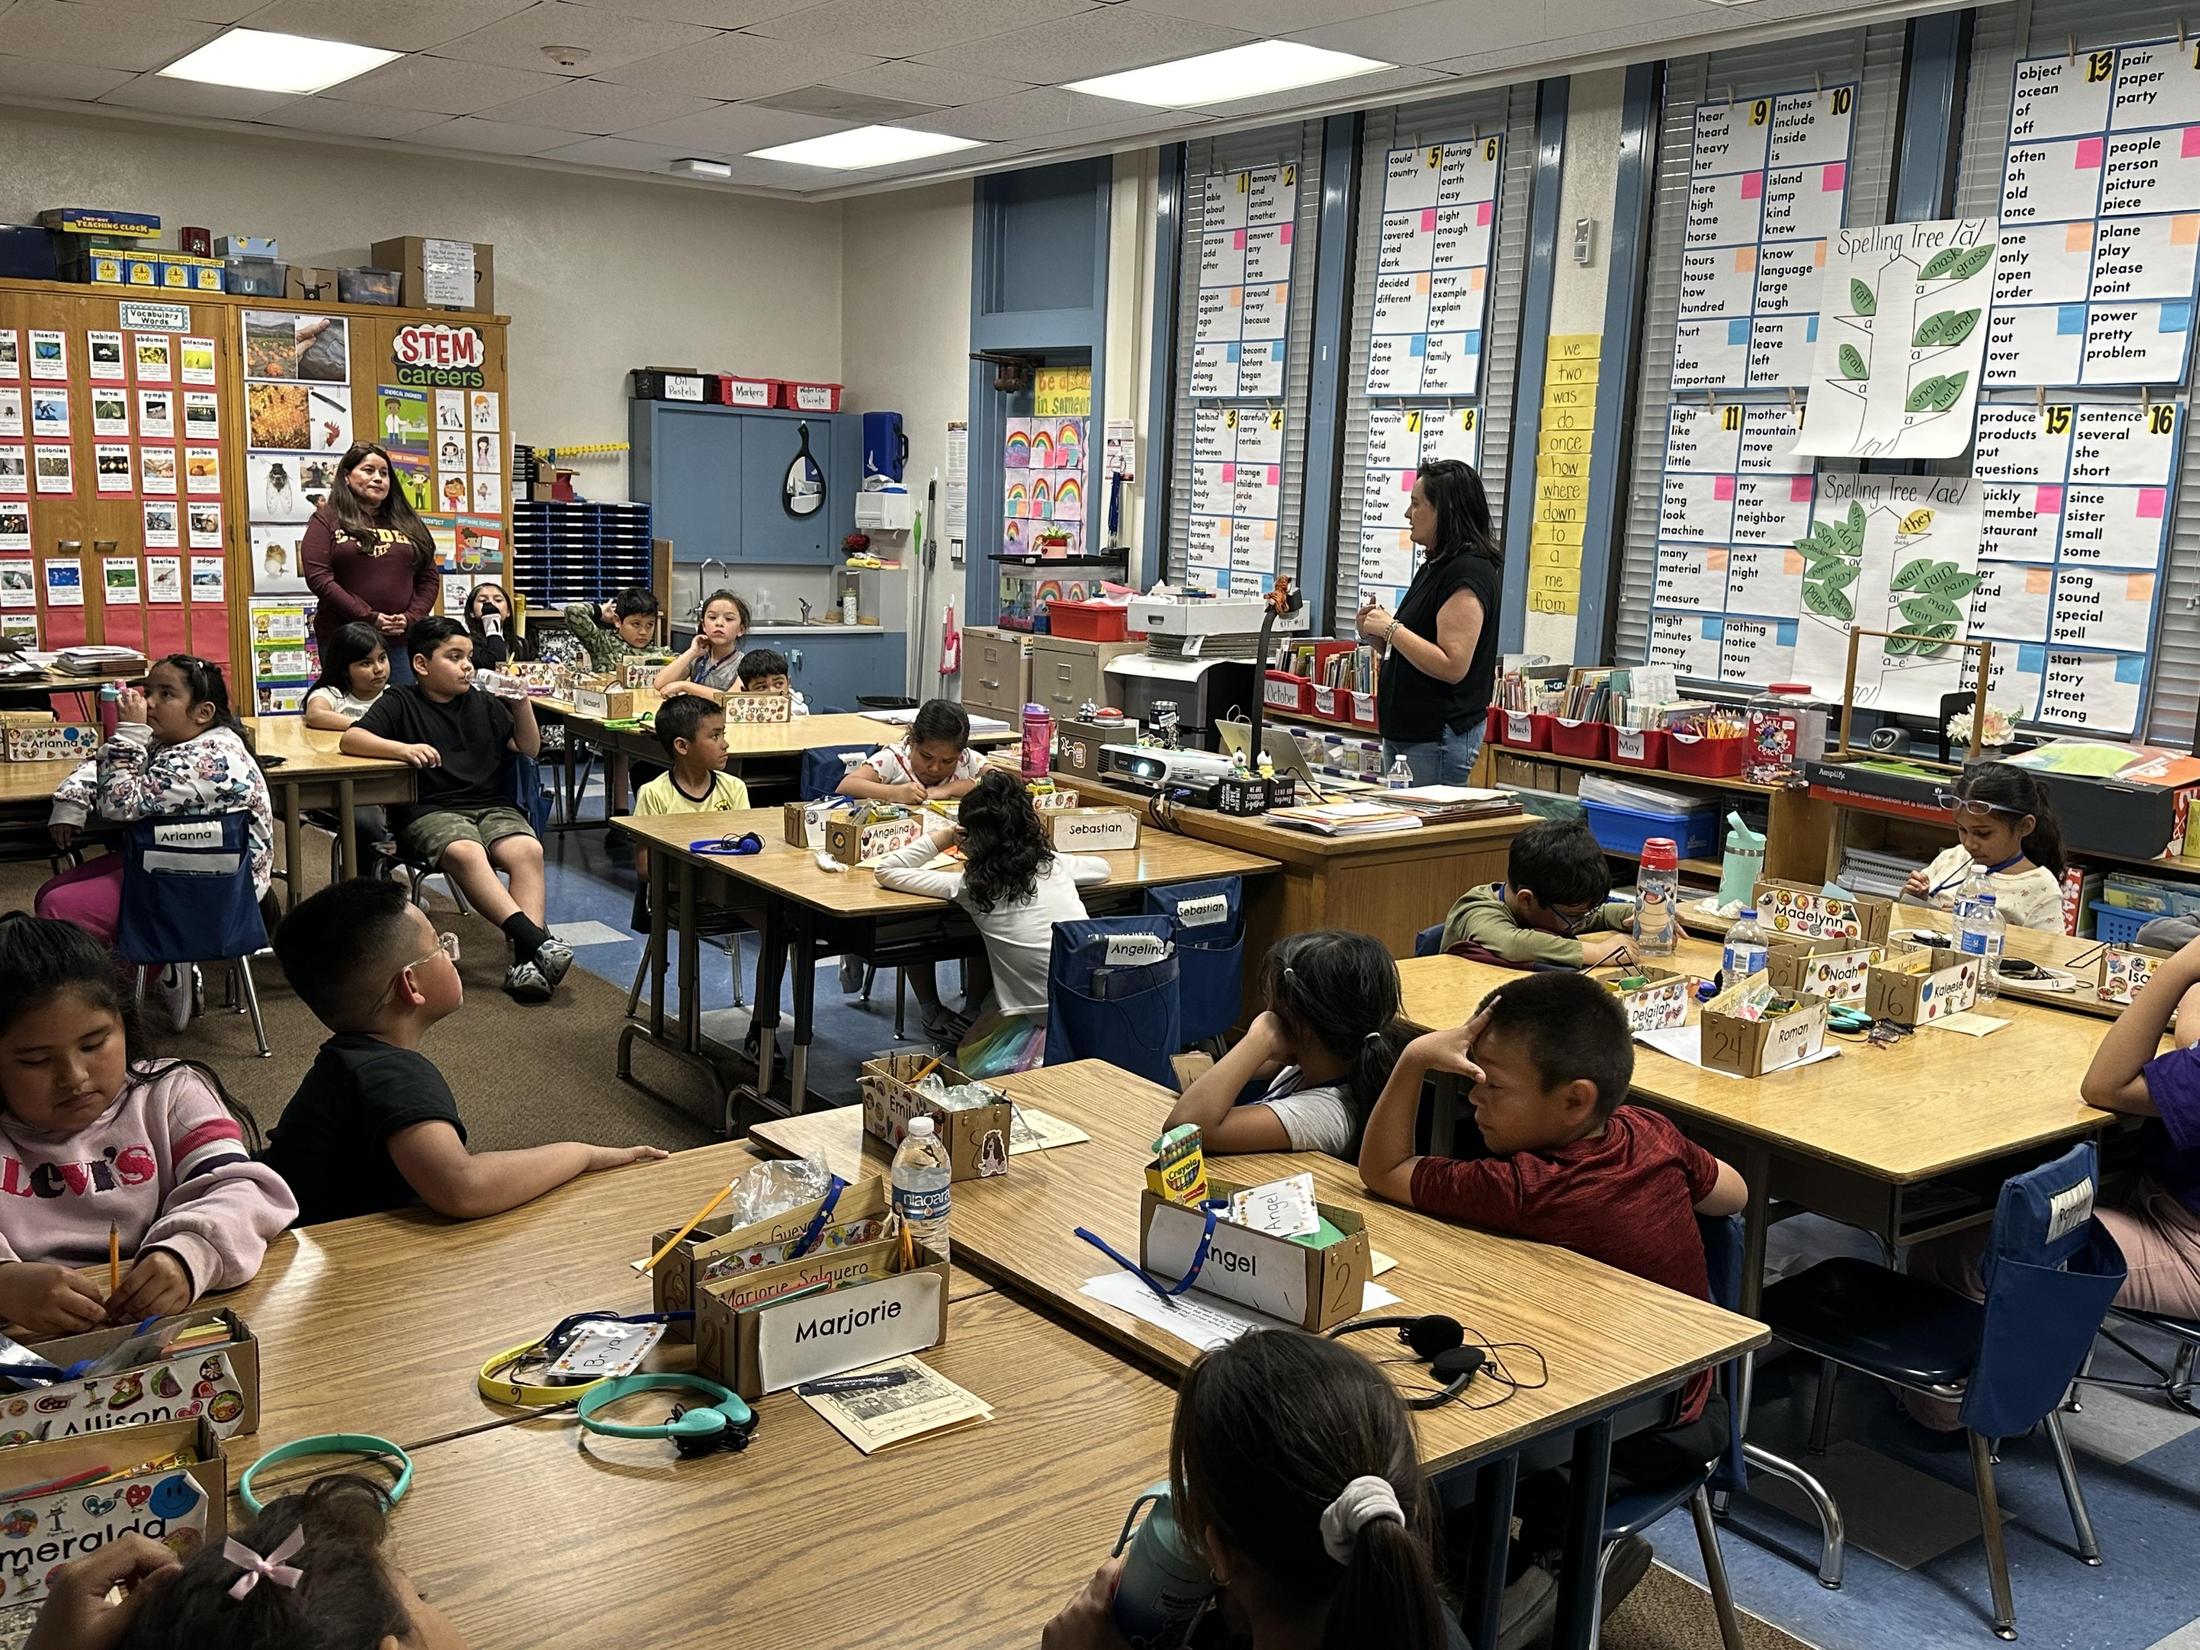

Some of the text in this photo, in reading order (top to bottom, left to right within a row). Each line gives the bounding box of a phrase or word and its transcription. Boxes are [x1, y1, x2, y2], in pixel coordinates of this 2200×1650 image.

[2020, 65, 2062, 81] object
[2088, 52, 2112, 82] 13
[2119, 70, 2164, 89] paper
[1832, 88, 1850, 115] 10
[1754, 100, 1766, 126] 9
[1775, 115, 1814, 128] include
[1445, 148, 1471, 158] during
[1487, 139, 1495, 161] 6
[1696, 143, 1728, 154] heavy
[2110, 138, 2161, 157] people
[1429, 146, 1440, 168] 5
[2010, 150, 2046, 164] often
[1285, 166, 1294, 187] 2
[1389, 168, 1418, 178] country
[1769, 173, 1802, 185] island
[1241, 174, 1245, 193] 1
[2105, 178, 2155, 192] picture
[1206, 205, 1224, 214] about
[1250, 211, 1276, 220] another
[76, 220, 148, 233] TEACHING CLOCK
[1438, 225, 1468, 236] enough
[1249, 231, 1273, 240] answer
[1688, 232, 1716, 242] horse
[1838, 227, 1903, 262] Spelling
[1910, 224, 1944, 248] Tree
[1929, 250, 1960, 274] mask
[1957, 249, 1986, 277] grass
[1761, 264, 1812, 276] language
[2096, 263, 2142, 278] please
[1378, 295, 1411, 304] different
[1996, 287, 2032, 299] order
[1681, 302, 1724, 312] hundred
[1758, 298, 1788, 310] laugh
[130, 310, 179, 320] Vocabulary
[1245, 316, 1270, 324] because
[1945, 311, 1973, 340] sand
[401, 330, 474, 365] STEM
[1564, 343, 1580, 355] we
[1427, 353, 1451, 362] family
[1841, 348, 1862, 374] grab
[2087, 348, 2146, 362] problem
[399, 368, 483, 387] careers
[1559, 366, 1582, 381] two
[1674, 375, 1725, 384] important
[1750, 372, 1778, 382] letter
[668, 386, 696, 396] Pastels
[736, 386, 764, 398] Markers
[1192, 384, 1217, 393] always
[1913, 379, 1939, 407] snap
[1553, 390, 1576, 404] was
[1228, 411, 1235, 428] 3
[1240, 413, 1269, 422] carefully
[1272, 411, 1281, 429] 4
[1371, 415, 1401, 423] favorite
[1409, 412, 1419, 431] 7
[1465, 410, 1474, 430] 8
[1558, 410, 1574, 428] do
[1673, 411, 1696, 421] light
[1726, 407, 1738, 430] 11
[1748, 411, 1786, 420] mother
[1980, 412, 2035, 424] produce
[2046, 407, 2071, 434] 15
[2080, 411, 2142, 423] sentence
[2151, 405, 2173, 434] 16
[1745, 427, 1796, 435] mountain
[2078, 429, 2129, 440] several
[1551, 436, 1582, 450] once
[1552, 458, 1578, 476] how
[1975, 464, 2038, 476] questions
[1237, 481, 1262, 489] children
[1367, 474, 1390, 483] finally
[1544, 482, 1580, 498] where
[1825, 476, 1879, 509] Spelling
[1889, 477, 1917, 501] Tree
[1544, 503, 1576, 521] down
[1737, 513, 1785, 524] neighbor
[2067, 511, 2105, 522] sister
[1852, 507, 1862, 532] stay
[1904, 511, 1932, 533] they
[1551, 525, 1565, 541] to
[1662, 527, 1704, 536] machine
[1818, 528, 1836, 548] say
[1838, 528, 1858, 552] day
[1551, 550, 1559, 562] a
[1361, 571, 1383, 579] found
[1828, 570, 1851, 584] play
[1898, 560, 1925, 585] wait
[1924, 565, 1953, 589] rain
[1545, 576, 1562, 587] me
[1944, 578, 1970, 595] pain
[1534, 592, 1566, 611] from
[1657, 595, 1699, 604] measure
[1805, 586, 1828, 611] paper
[1905, 603, 1932, 622] train
[1928, 598, 1954, 616] mail
[2056, 609, 2103, 622] special
[1726, 623, 1766, 635] nothing
[1267, 683, 1296, 705] October
[614, 701, 630, 712] 23
[2044, 706, 2087, 722] strong
[1509, 724, 1530, 734] March
[31, 739, 78, 748] Arianna
[1619, 741, 1640, 753] May
[1819, 768, 1846, 780] Amplify
[872, 825, 909, 839] Angelina
[1069, 823, 1122, 834] Sebastian
[161, 831, 212, 841] Arianna
[1179, 903, 1224, 917] Sebastian
[1774, 904, 1843, 929] Madelynn
[1873, 916, 1888, 945] 20
[1830, 968, 1858, 980] Noah
[1879, 984, 1902, 1016] 16
[1779, 1024, 1808, 1043] Roman
[1712, 1032, 1743, 1066] 24
[1169, 1160, 1197, 1179] Crayola
[904, 1189, 950, 1209] niagara
[1263, 1191, 1286, 1231] Angel
[1203, 1245, 1256, 1276] ngel
[1331, 1263, 1350, 1312] 2
[795, 1299, 902, 1343] Marjorie
